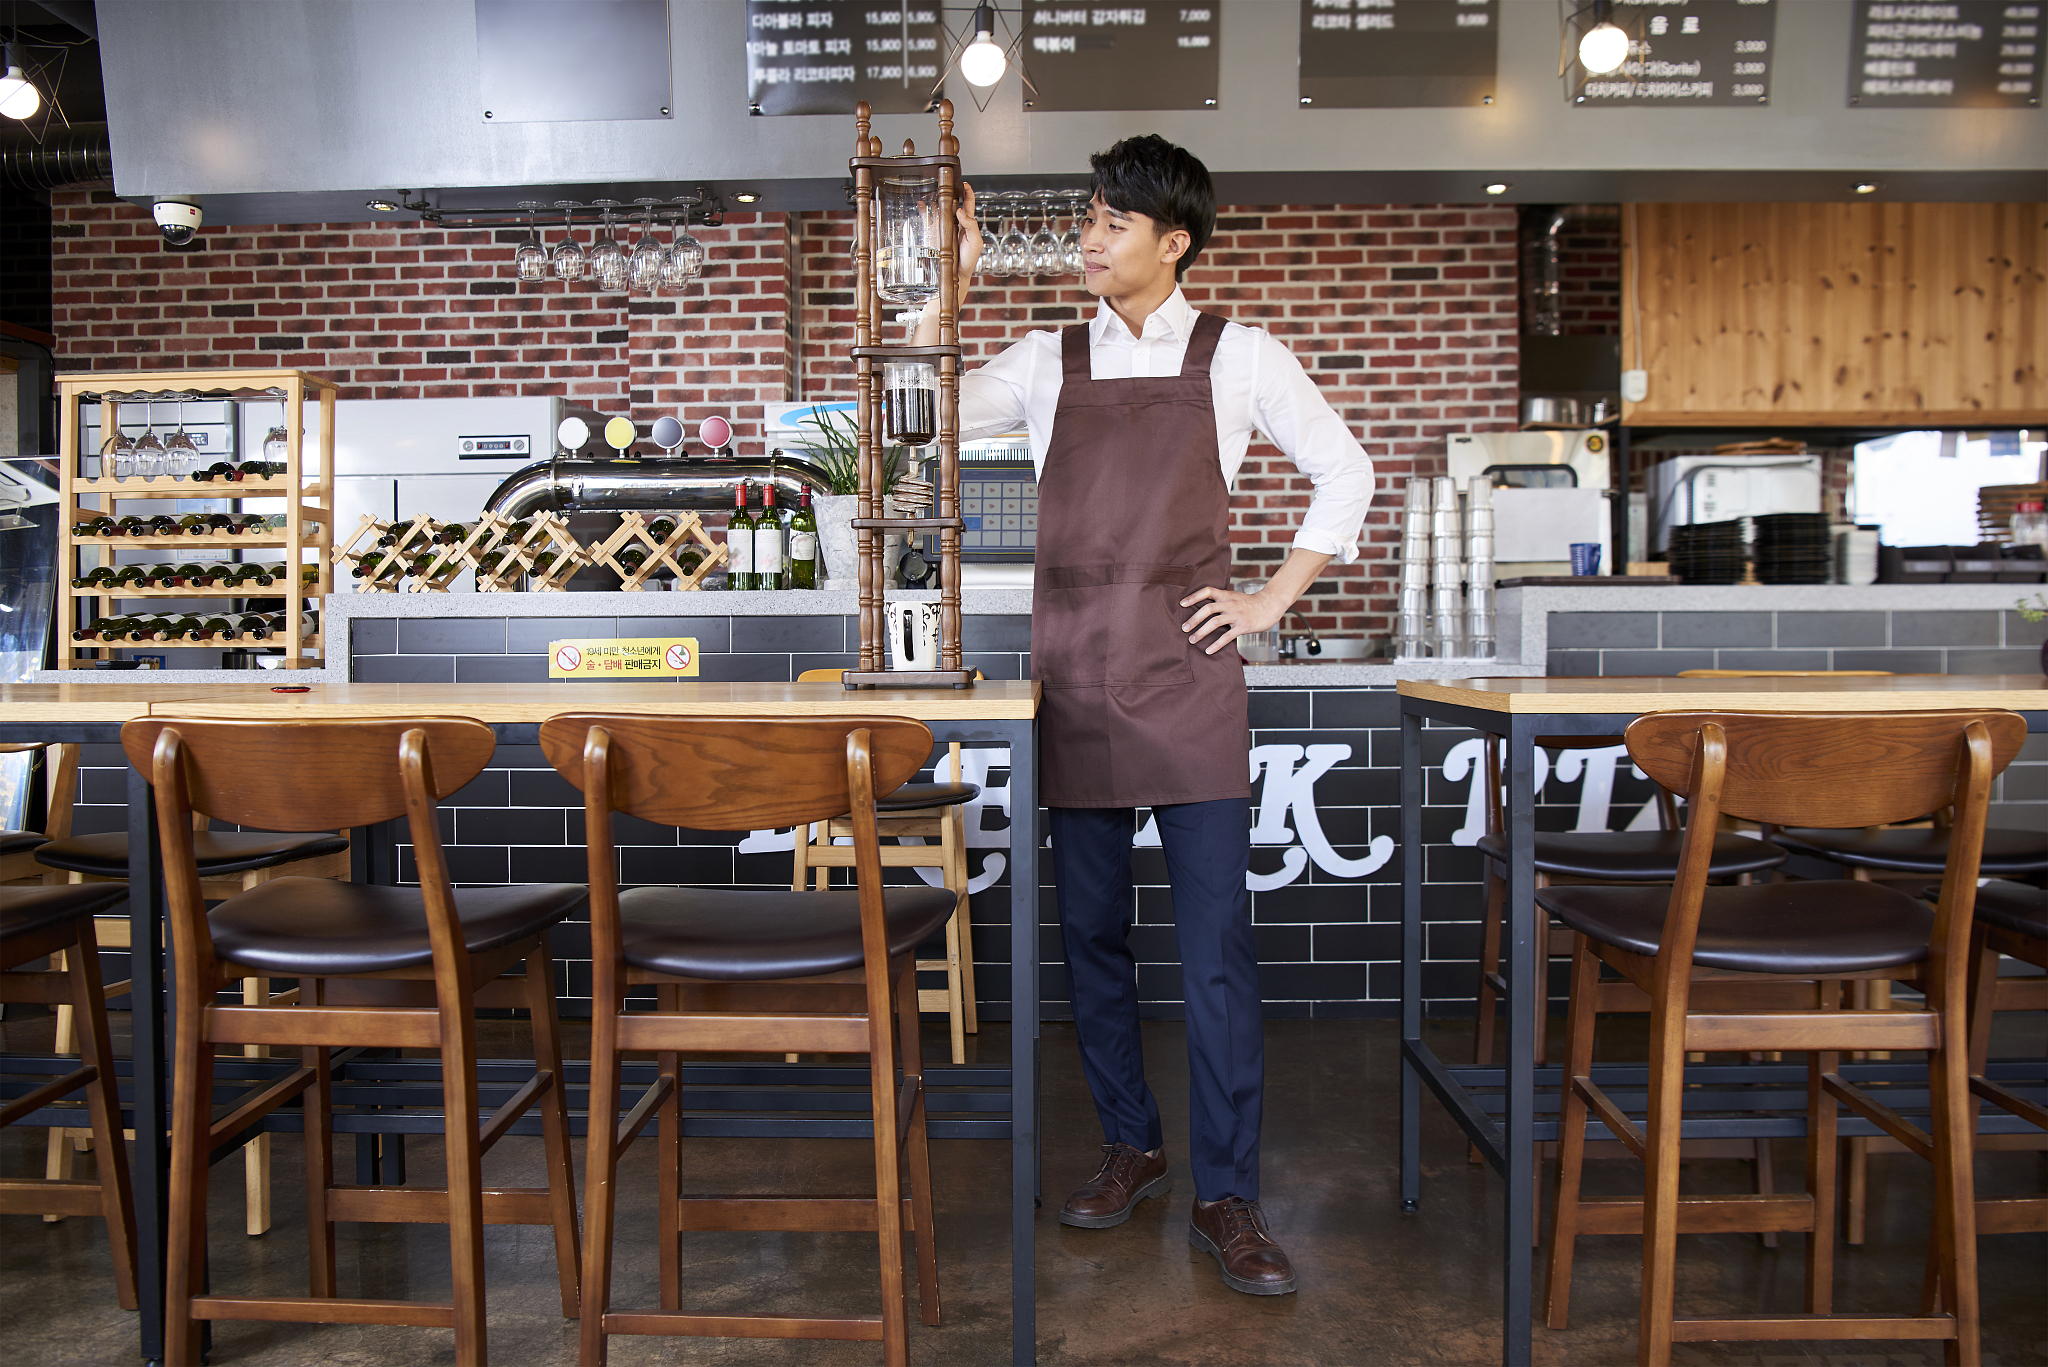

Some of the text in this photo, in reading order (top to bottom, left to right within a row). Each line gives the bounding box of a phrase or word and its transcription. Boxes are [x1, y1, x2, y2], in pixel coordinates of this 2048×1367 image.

[807, 11, 833, 28] 피자
[865, 11, 900, 25] 15,900
[1092, 9, 1146, 26] 감자튀김
[1180, 10, 1210, 22] 7,000
[1649, 16, 1700, 35] 음 료
[782, 40, 821, 55] 토마토
[825, 39, 851, 54] 피자
[866, 39, 901, 52] 15,900
[866, 67, 902, 80] 17,900
[604, 646, 619, 656] 미만
[622, 645, 661, 656] 청소년에게
[625, 659, 661, 670] 판매금지
